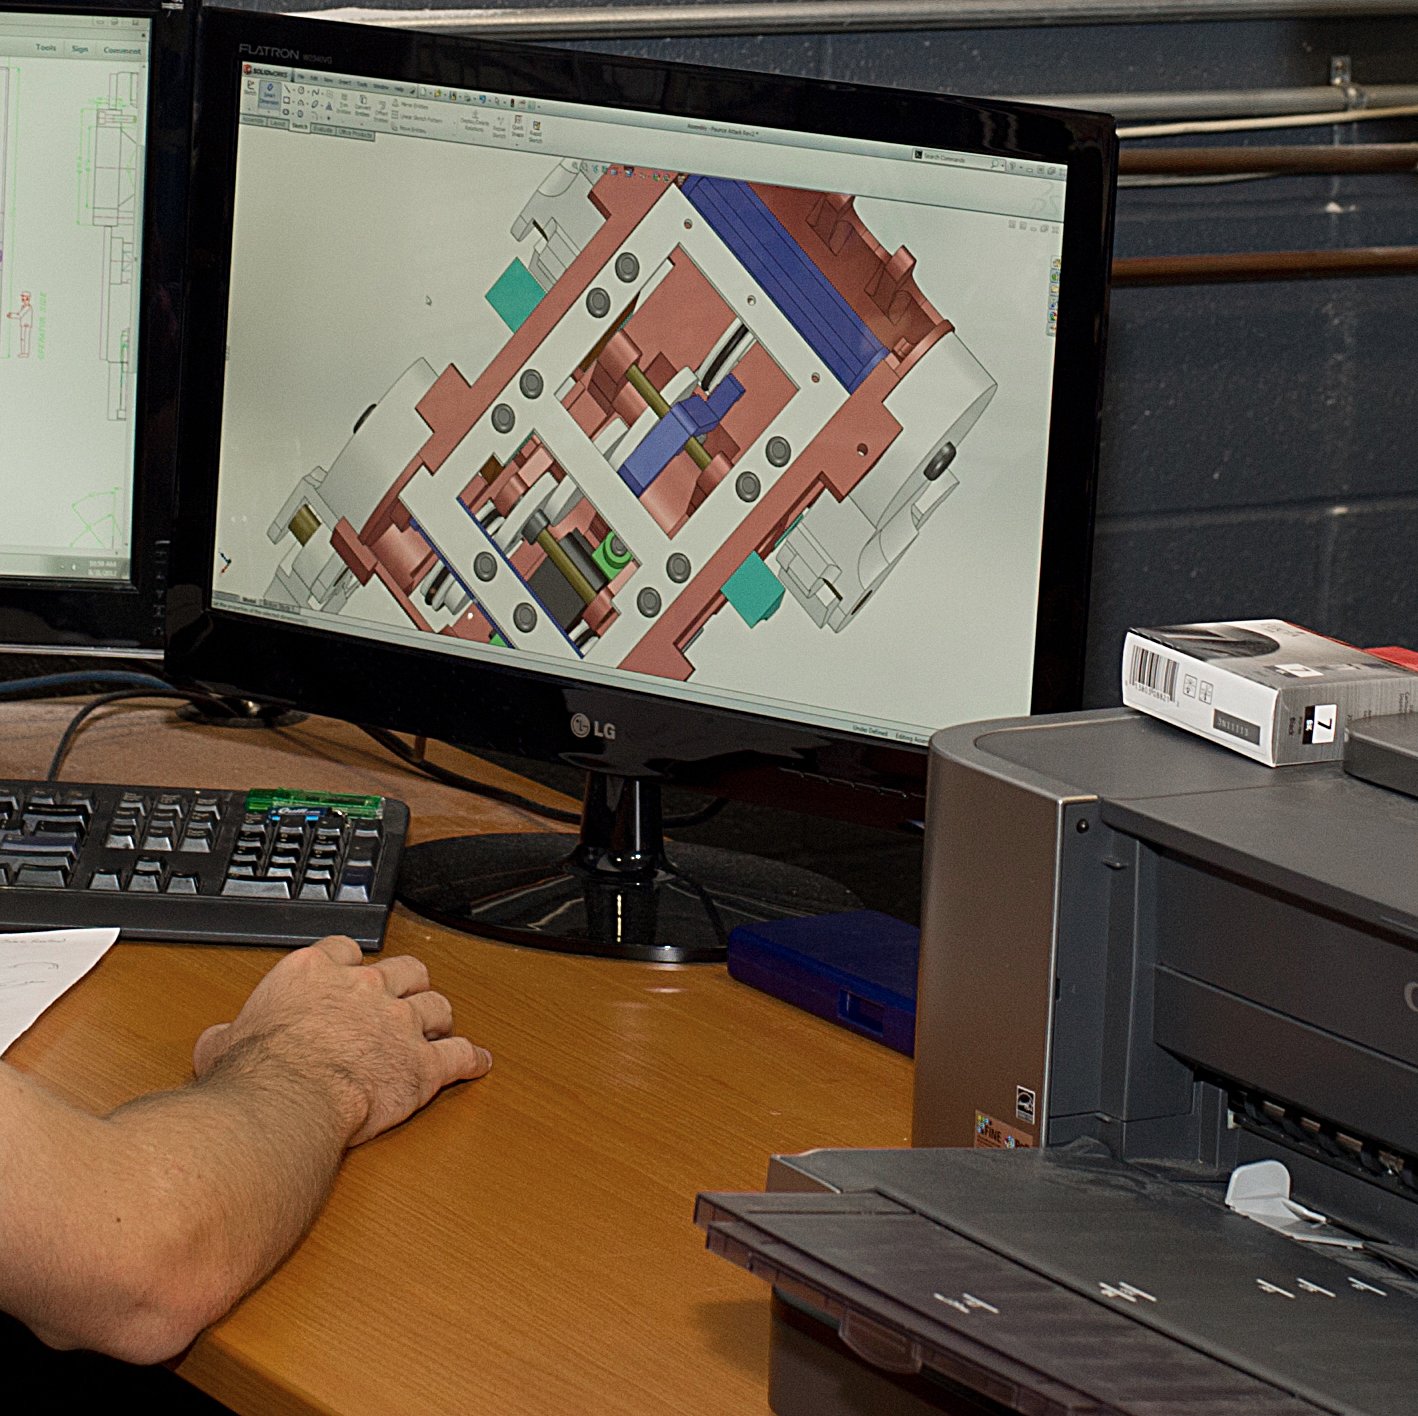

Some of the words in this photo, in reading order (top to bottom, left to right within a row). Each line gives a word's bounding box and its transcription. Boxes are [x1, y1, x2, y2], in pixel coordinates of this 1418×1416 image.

[36, 43, 56, 52] Tools
[72, 45, 88, 53] Sign
[103, 46, 141, 55] Comment
[239, 43, 300, 60] FLATRON
[253, 68, 288, 77] SOLIDWORKS
[1318, 719, 1332, 730] 7
[594, 721, 616, 739] LG
